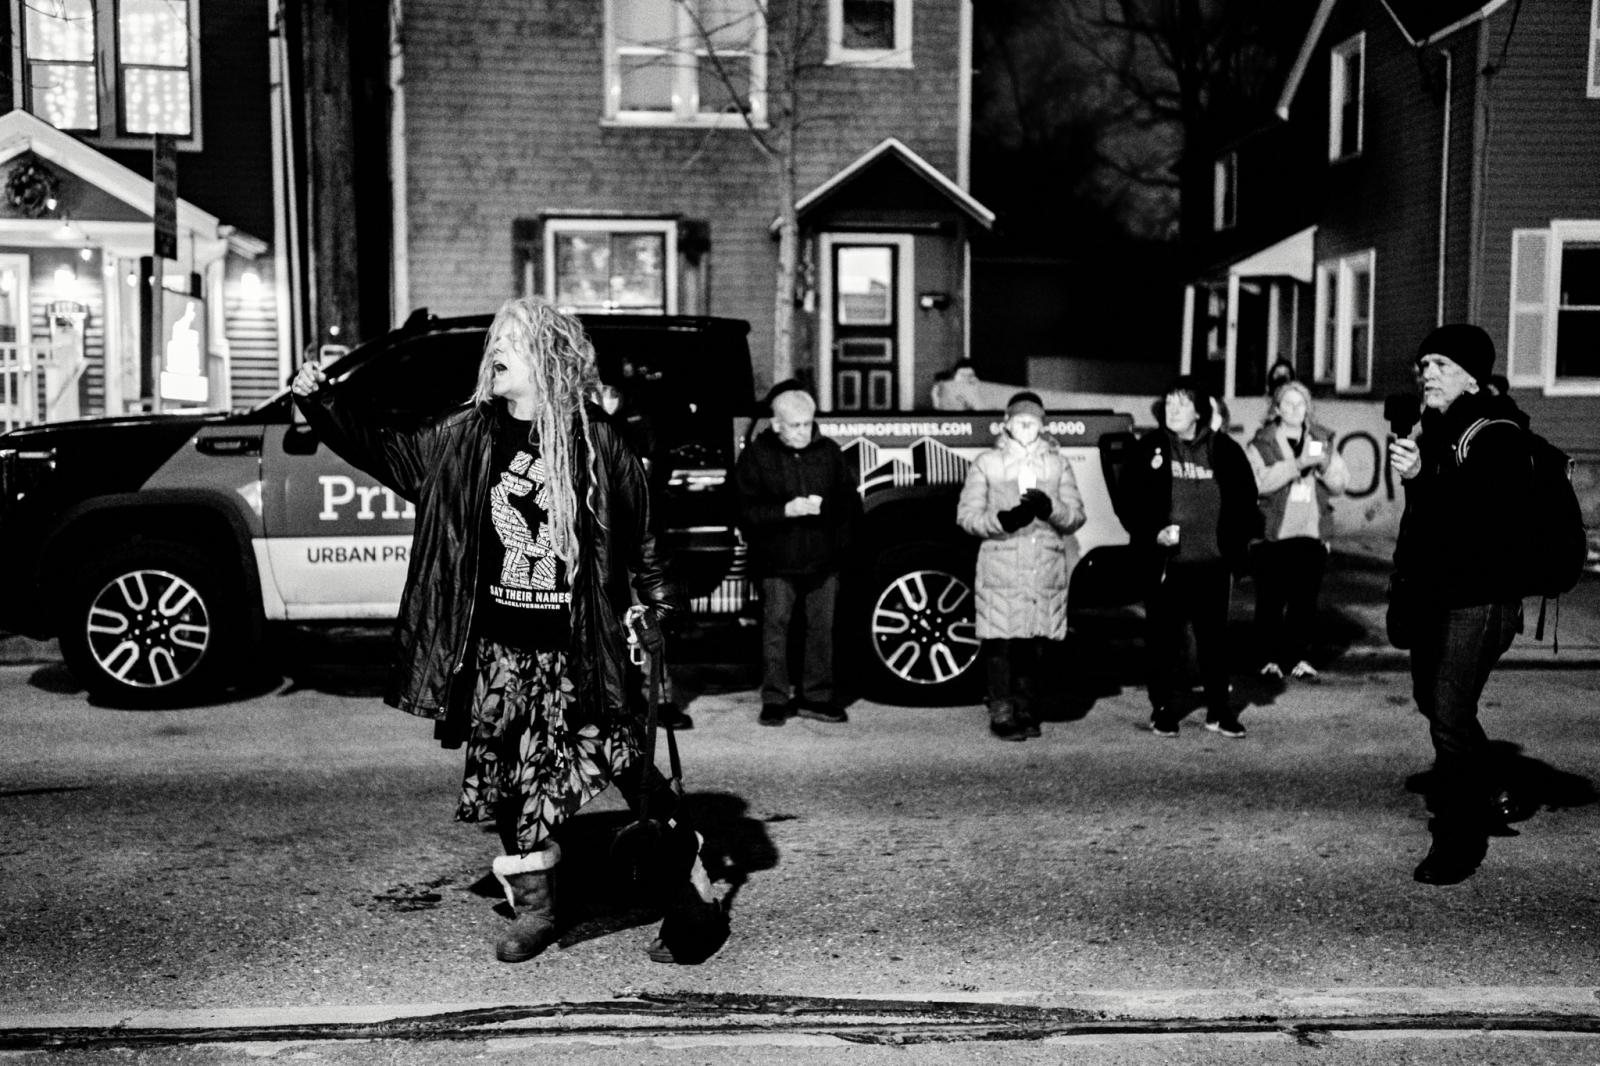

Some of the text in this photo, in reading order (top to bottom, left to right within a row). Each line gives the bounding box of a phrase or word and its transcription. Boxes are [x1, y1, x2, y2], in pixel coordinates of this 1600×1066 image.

[819, 422, 972, 436] RBANPROPERTIES.COM
[307, 546, 411, 563] URBAN PR
[490, 585, 572, 604] SAY THEIR NAMES
